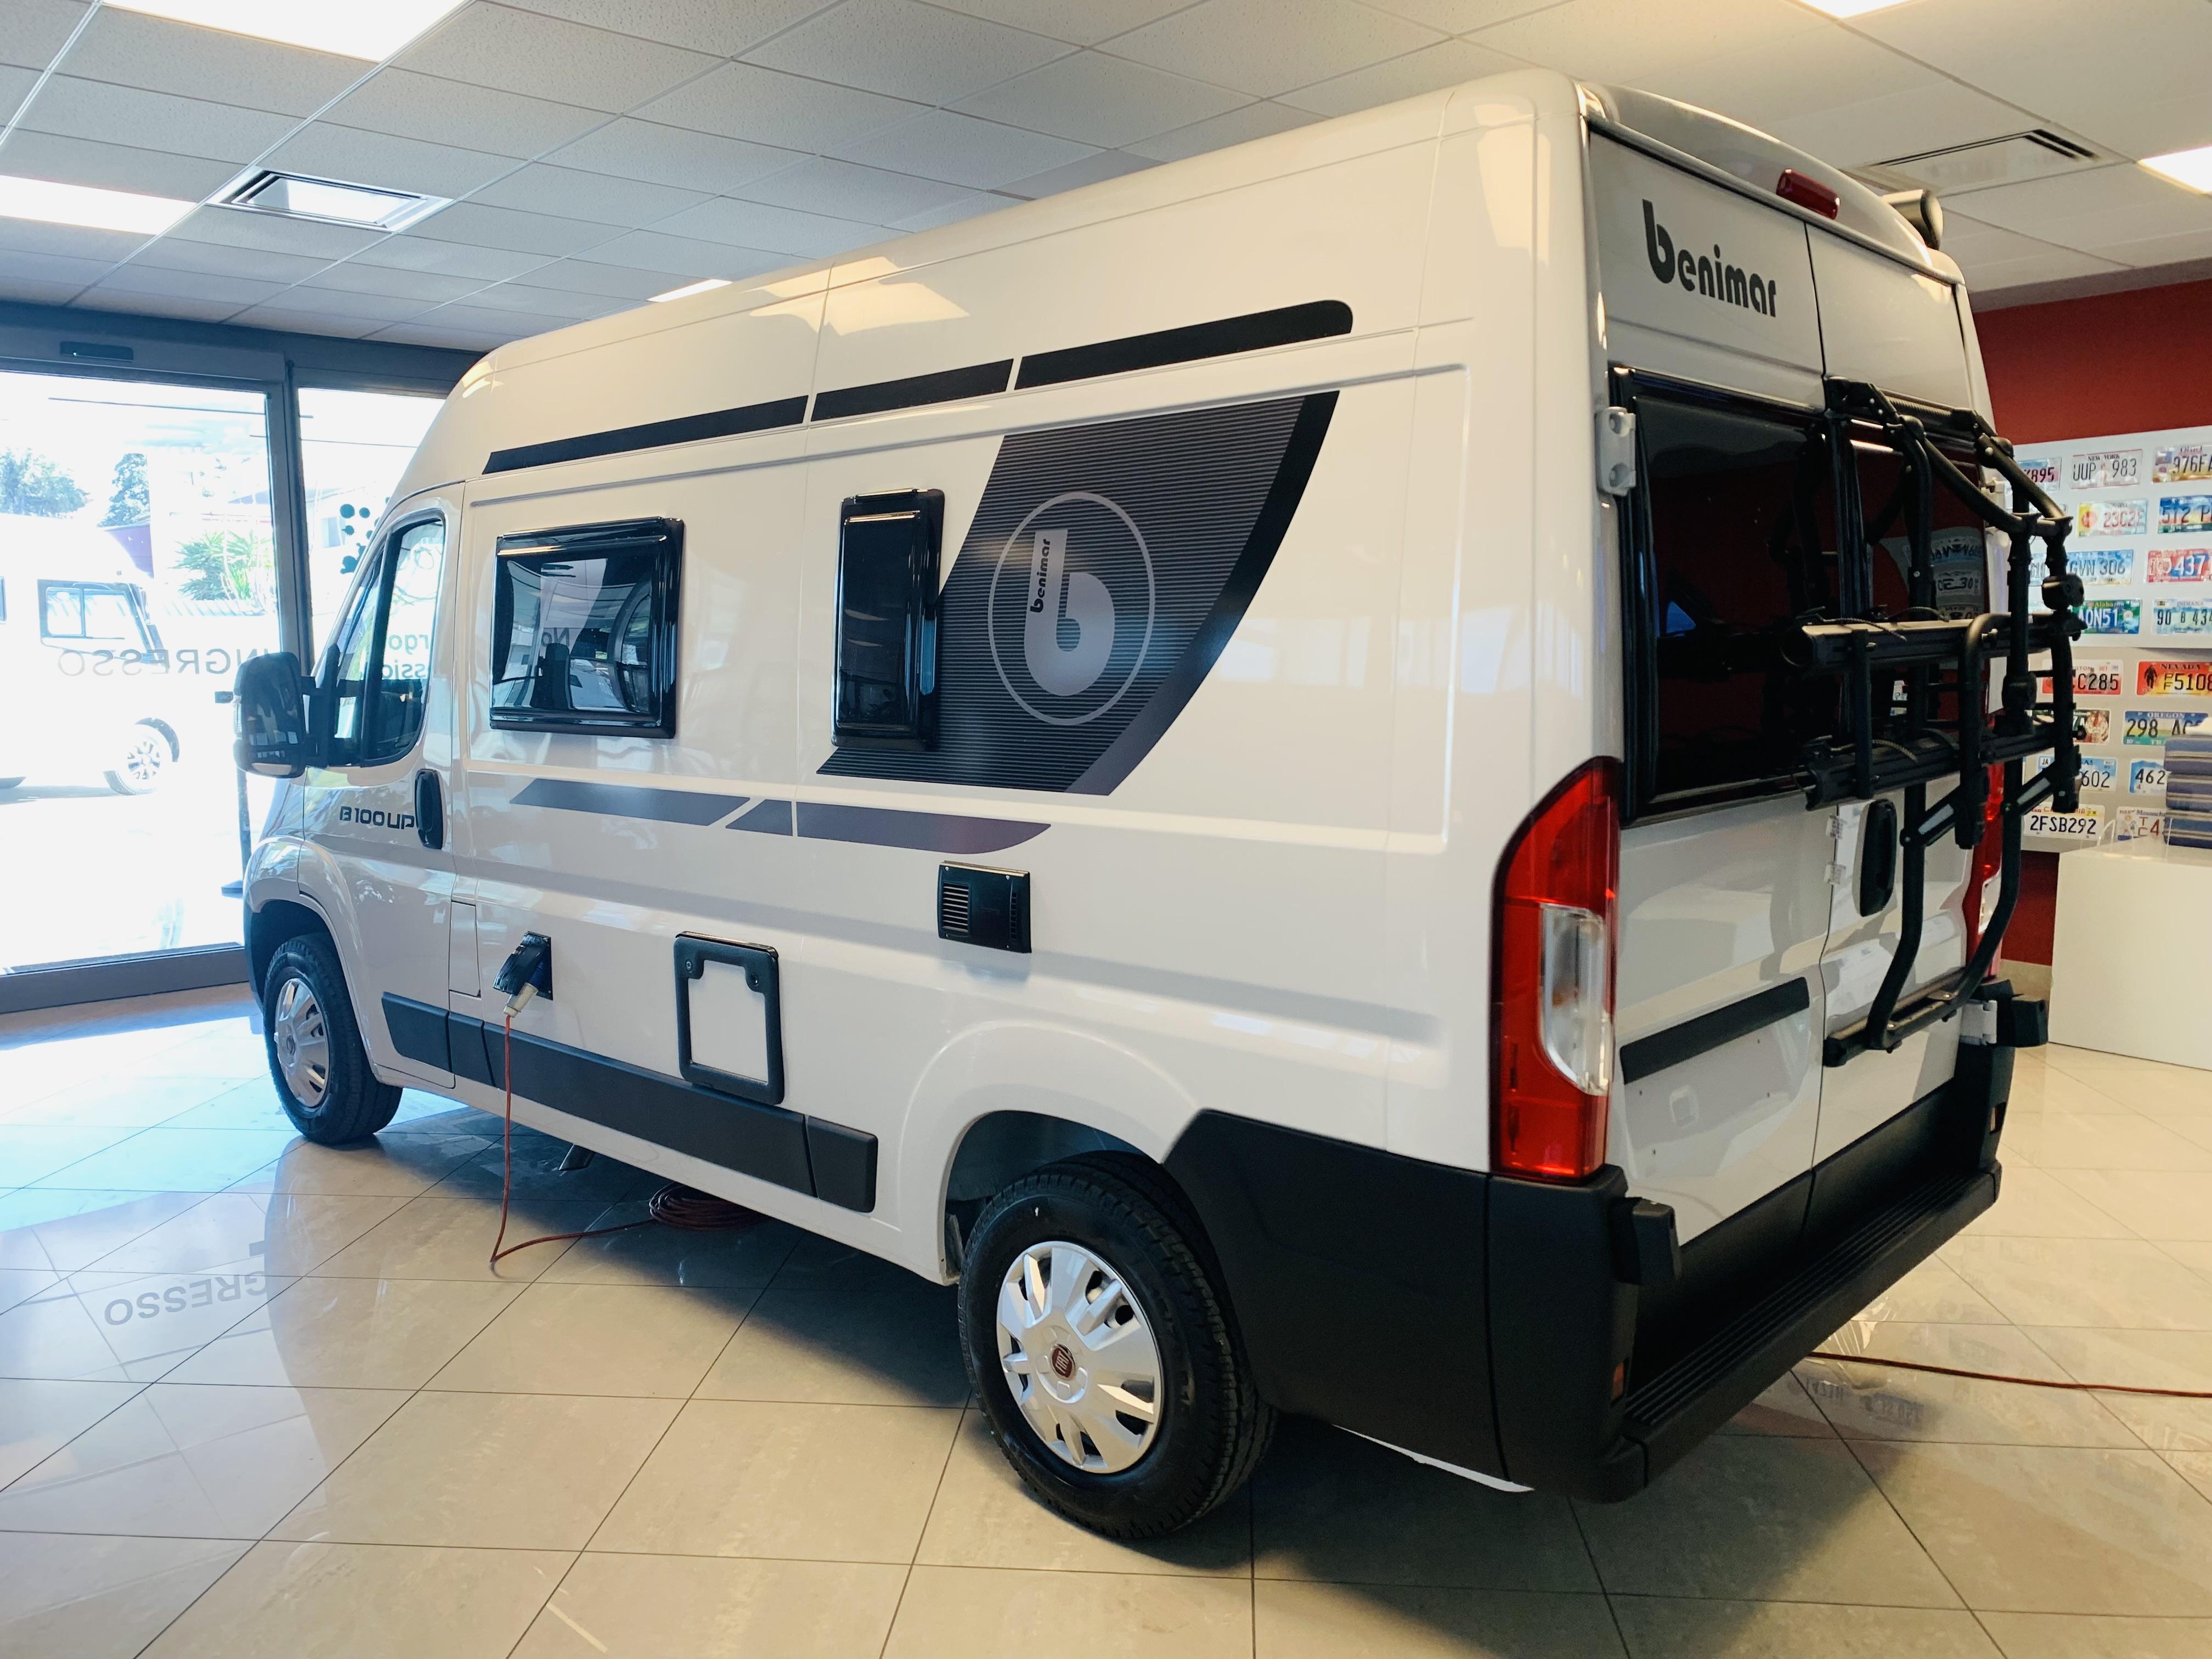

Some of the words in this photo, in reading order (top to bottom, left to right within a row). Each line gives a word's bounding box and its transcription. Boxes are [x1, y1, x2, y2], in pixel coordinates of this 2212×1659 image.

[1642, 199, 1776, 317] benimar
[2112, 458, 2137, 478] 983
[1030, 539, 1050, 613] benimar
[2099, 558, 2125, 575] 306
[2157, 609, 2171, 625] 90
[2073, 673, 2119, 690] C285
[2126, 718, 2158, 738] 298
[2135, 769, 2166, 785] 462
[2030, 815, 2096, 834] 2FSB292
[1055, 1351, 1069, 1374] FIAT
